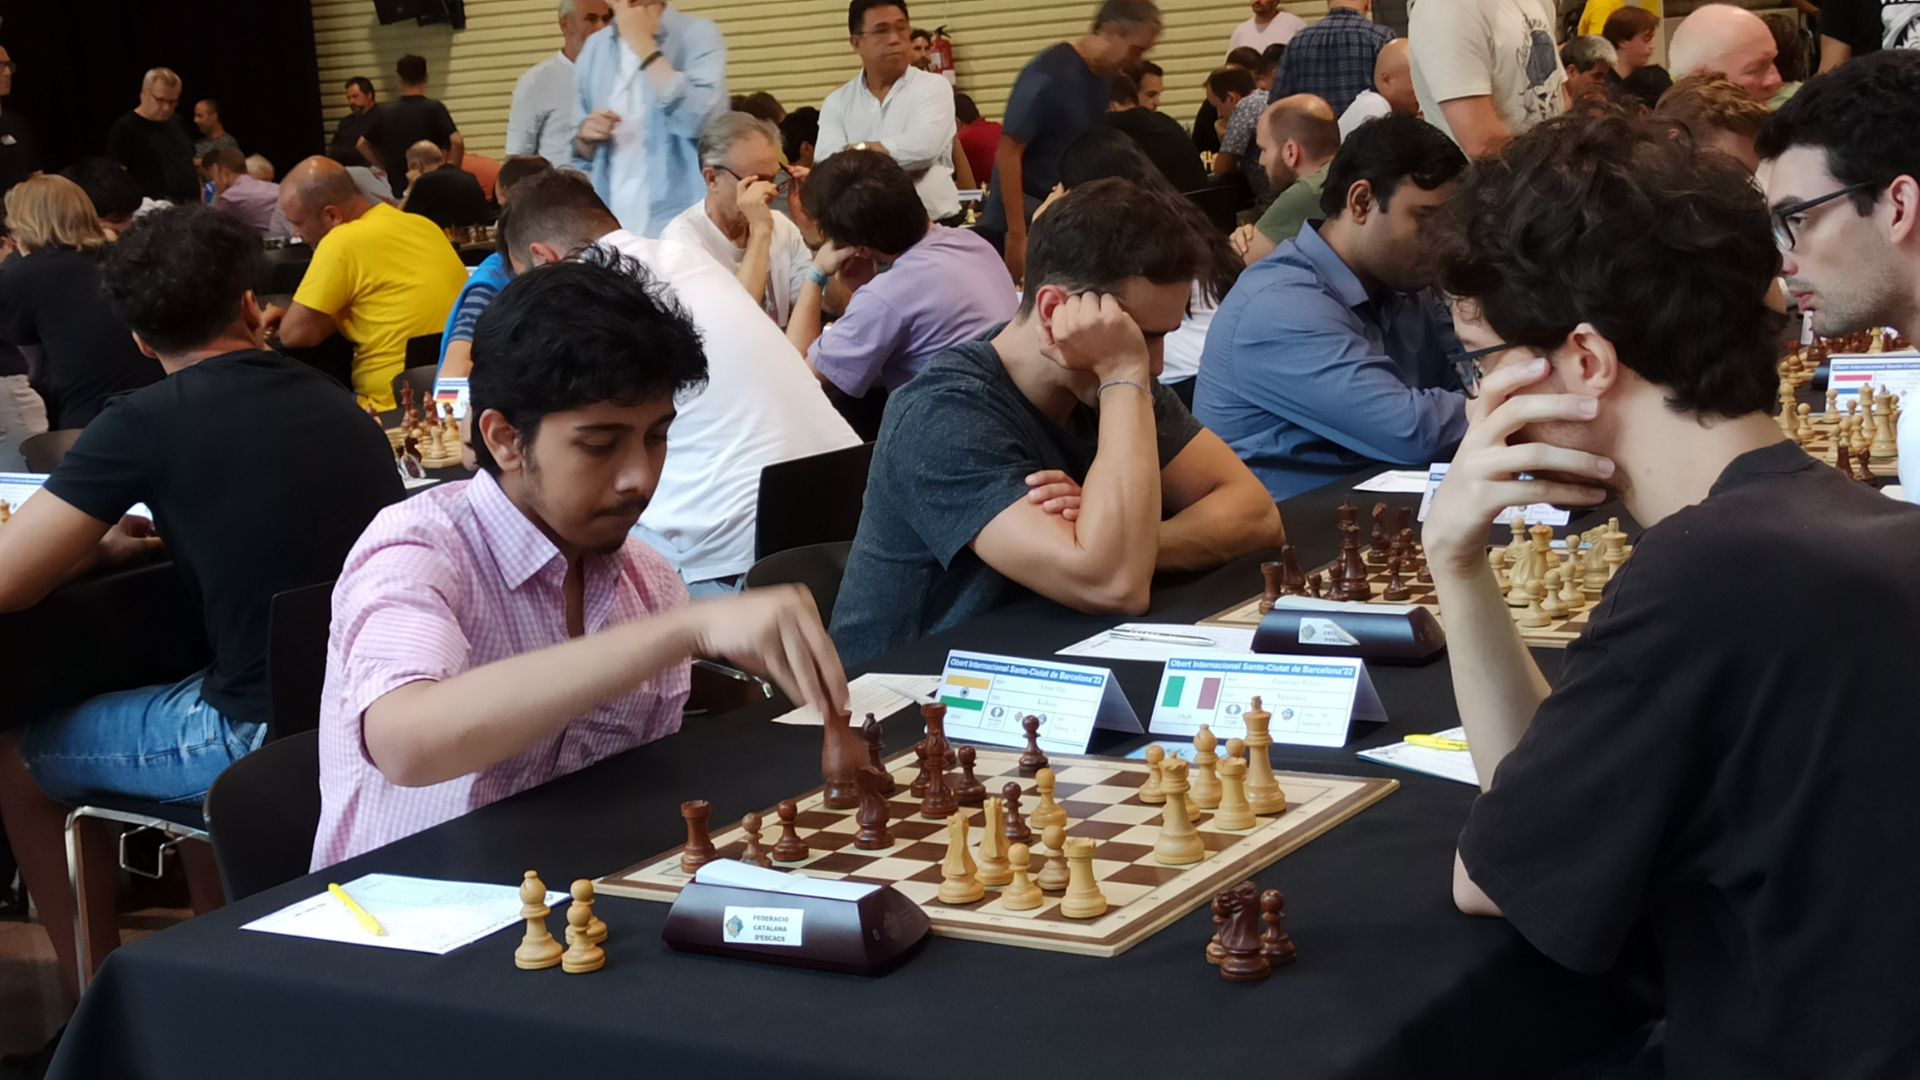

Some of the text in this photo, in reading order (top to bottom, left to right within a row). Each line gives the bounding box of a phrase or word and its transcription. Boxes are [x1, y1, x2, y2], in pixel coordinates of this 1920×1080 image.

[950, 658, 969, 668] Obert
[969, 660, 1010, 673] Internacional
[1050, 670, 1059, 679] de
[1059, 671, 1103, 685] Barcelona'22
[1170, 659, 1192, 668] Obert
[1192, 660, 1242, 671] Internacional
[1291, 664, 1301, 673] de
[1302, 665, 1354, 676] Barcelona'22
